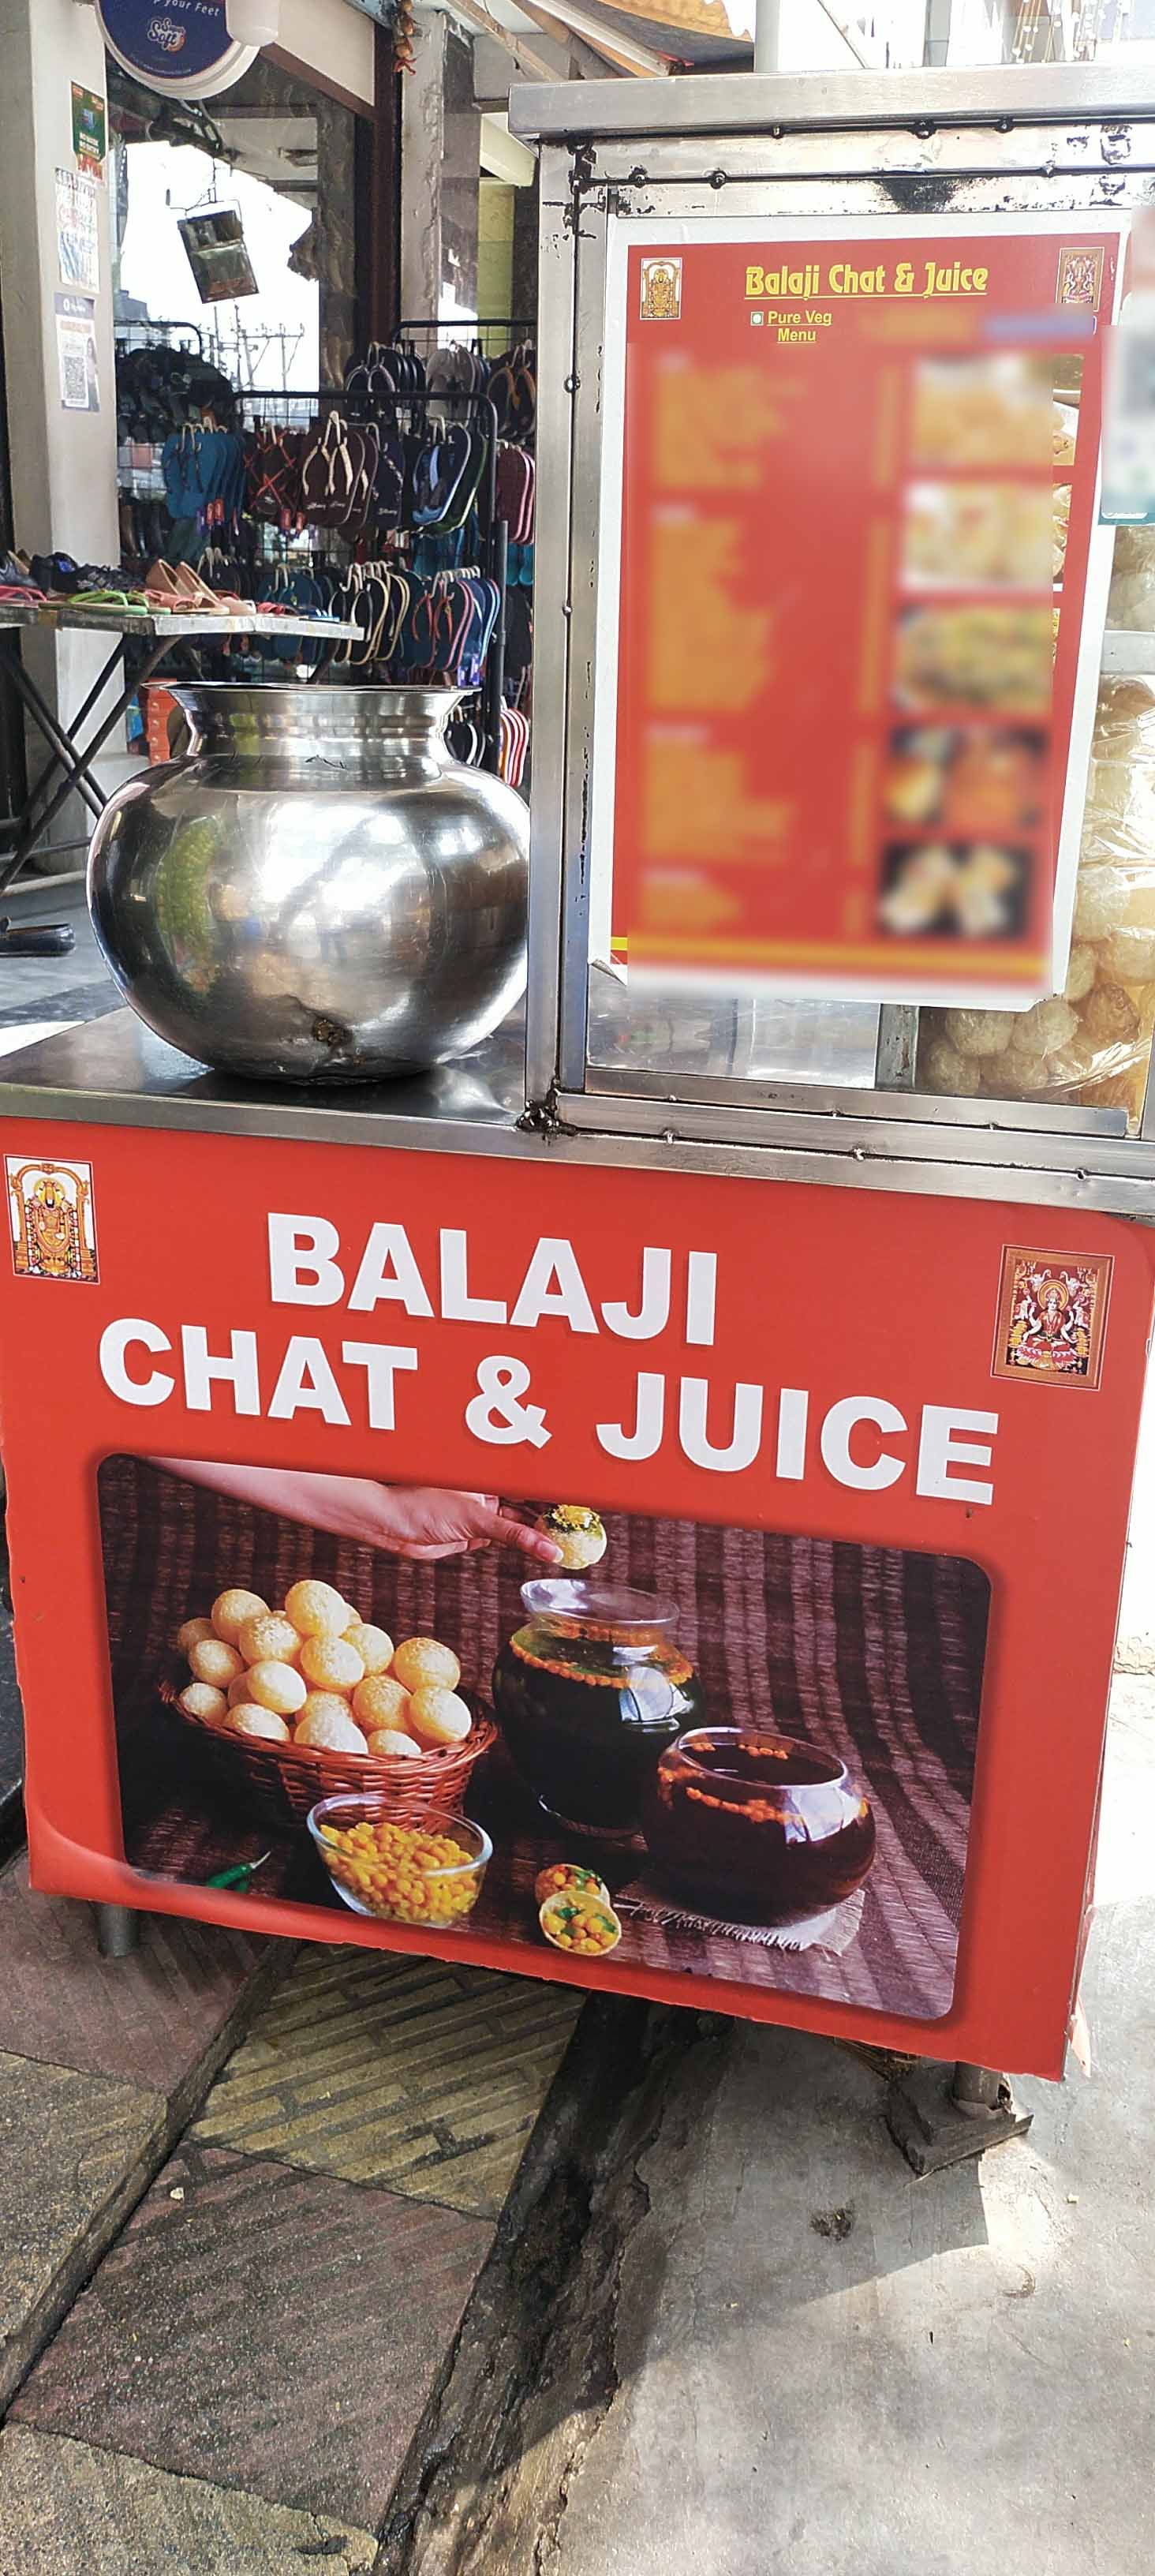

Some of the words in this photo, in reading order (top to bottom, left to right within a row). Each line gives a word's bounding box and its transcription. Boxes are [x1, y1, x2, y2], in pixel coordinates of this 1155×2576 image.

[745, 264, 820, 301] Balaji
[828, 264, 886, 294] Chat
[893, 262, 916, 293] &
[923, 261, 989, 300] Juice
[767, 311, 802, 324] Pure
[805, 309, 832, 327] Veg
[777, 328, 817, 342] Menu
[267, 1211, 719, 1346] BALAJI
[98, 1317, 419, 1432] CHAT
[464, 1354, 553, 1450] &
[595, 1371, 1000, 1507] JUICE
